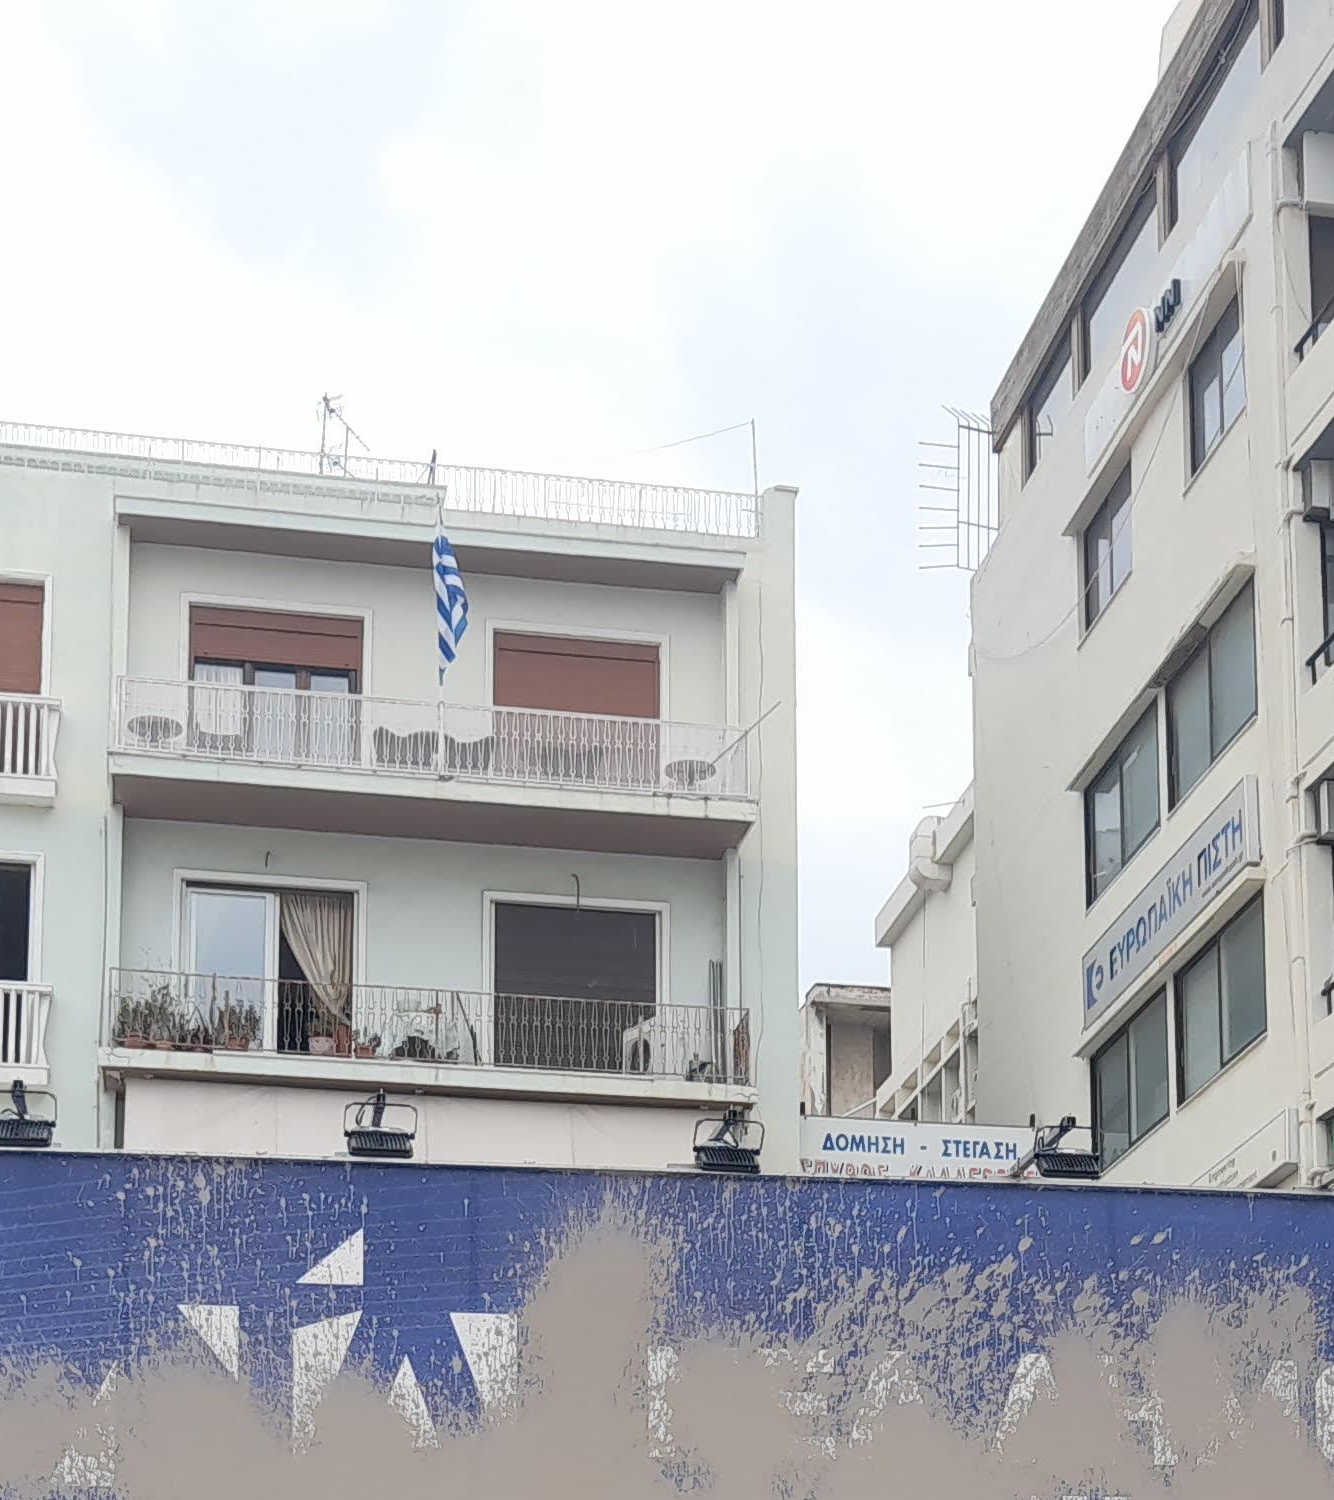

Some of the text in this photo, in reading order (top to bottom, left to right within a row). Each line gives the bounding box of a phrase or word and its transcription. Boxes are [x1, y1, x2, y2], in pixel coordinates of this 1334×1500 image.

[1109, 862, 1193, 982] ΕΥΡΩΠΑΪΚΗ
[1197, 808, 1243, 888] ΠΙΣΤΗ
[821, 1133, 905, 1156] ΔΟΜΗΣΗ
